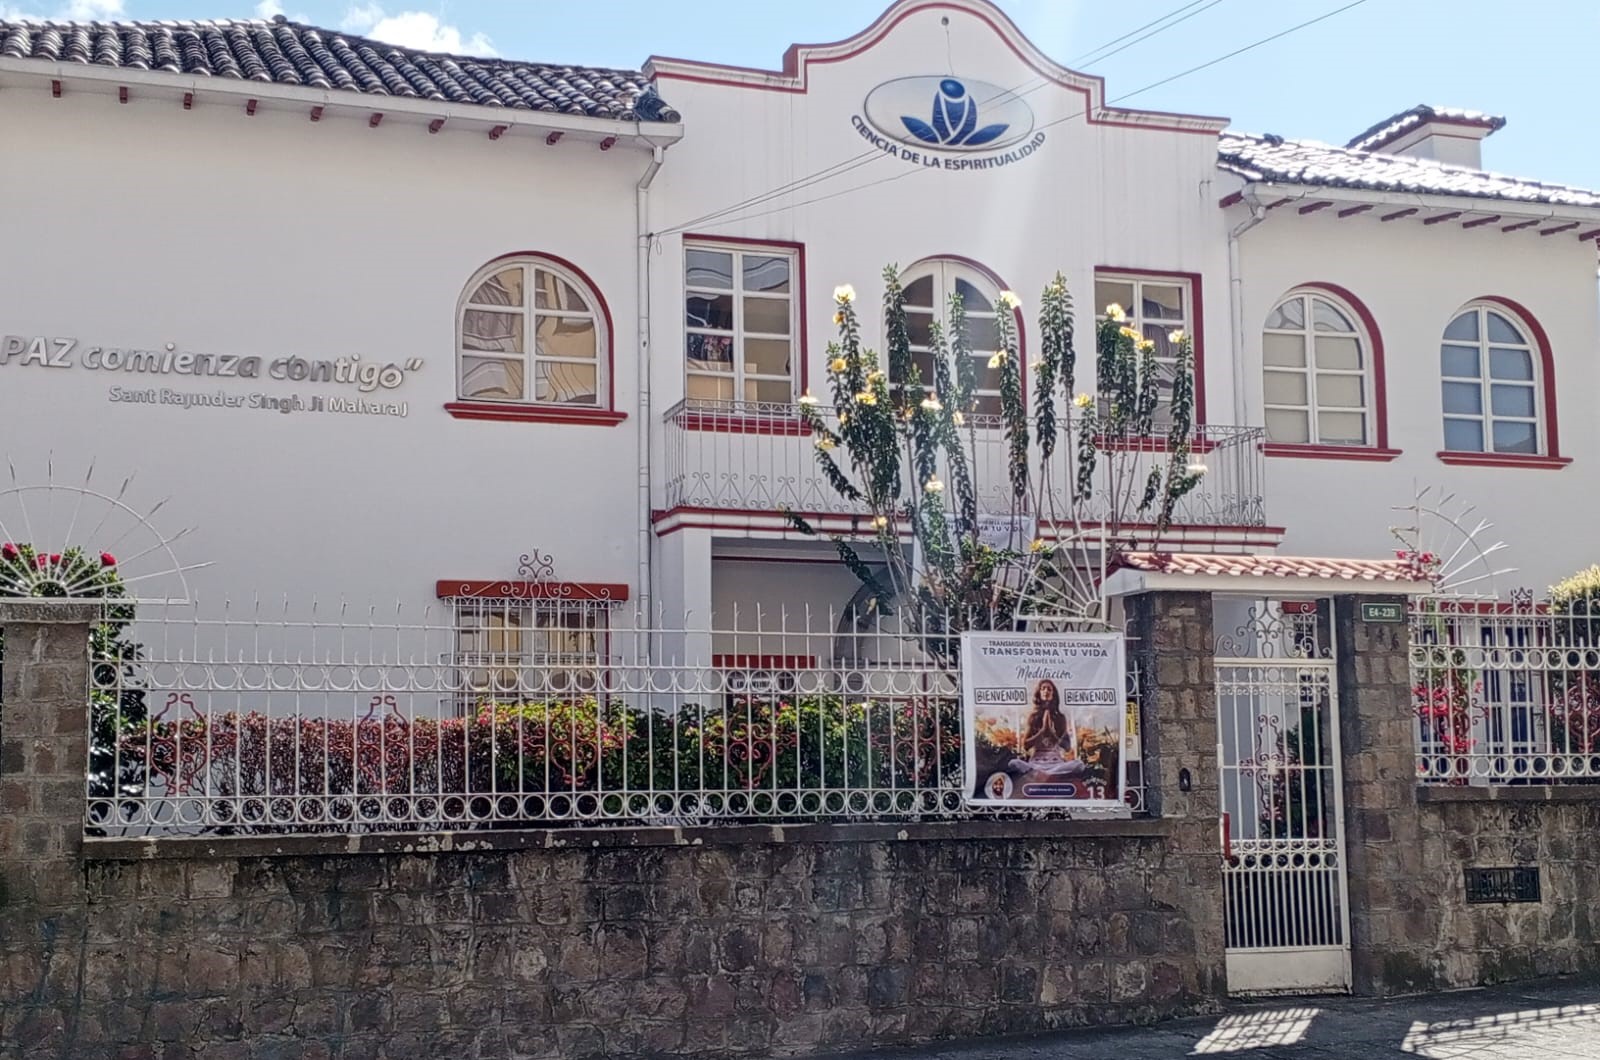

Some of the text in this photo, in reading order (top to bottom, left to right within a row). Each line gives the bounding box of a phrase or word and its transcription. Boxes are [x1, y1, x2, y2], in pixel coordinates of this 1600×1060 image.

[851, 114, 1046, 171] CIENCIA DE LA ESPIRITUALIDAD
[0, 335, 77, 368] PAZ
[81, 342, 261, 378] comienza
[109, 386, 156, 404] Sant
[160, 388, 245, 409] Rajinder
[249, 392, 305, 414] Singh
[328, 397, 408, 417] Maharaj
[982, 647, 1108, 657] TRANSFORMA TU VIDA
[1016, 665, 1073, 681] Meditación
[976, 689, 1115, 702] BIENVENIDO BIENVENIDO
[1086, 786, 1105, 800] 13
